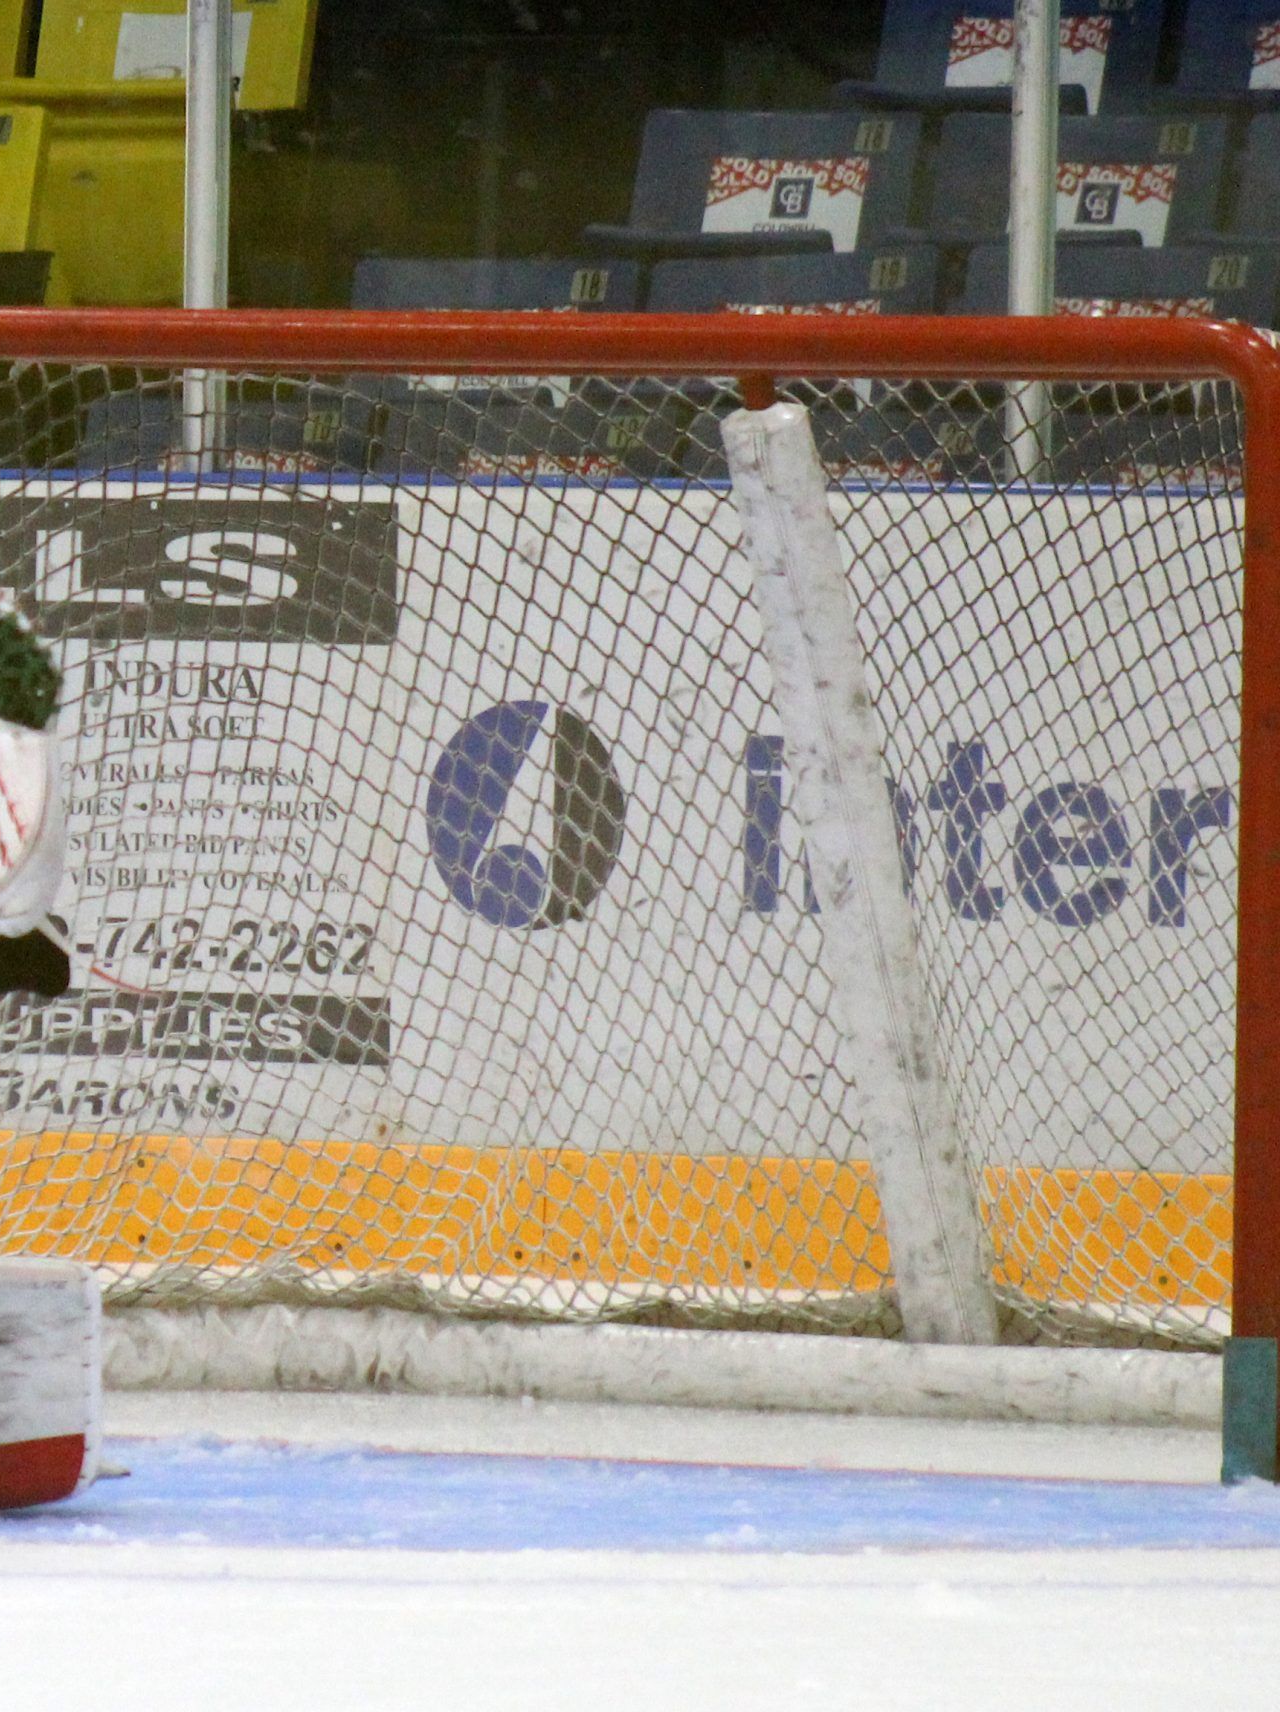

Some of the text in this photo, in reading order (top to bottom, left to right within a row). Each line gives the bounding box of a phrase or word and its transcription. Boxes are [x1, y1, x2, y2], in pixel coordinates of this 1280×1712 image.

[86, 659, 259, 700] INDURA
[61, 796, 120, 817] DIES
[743, 734, 1231, 928] iter
